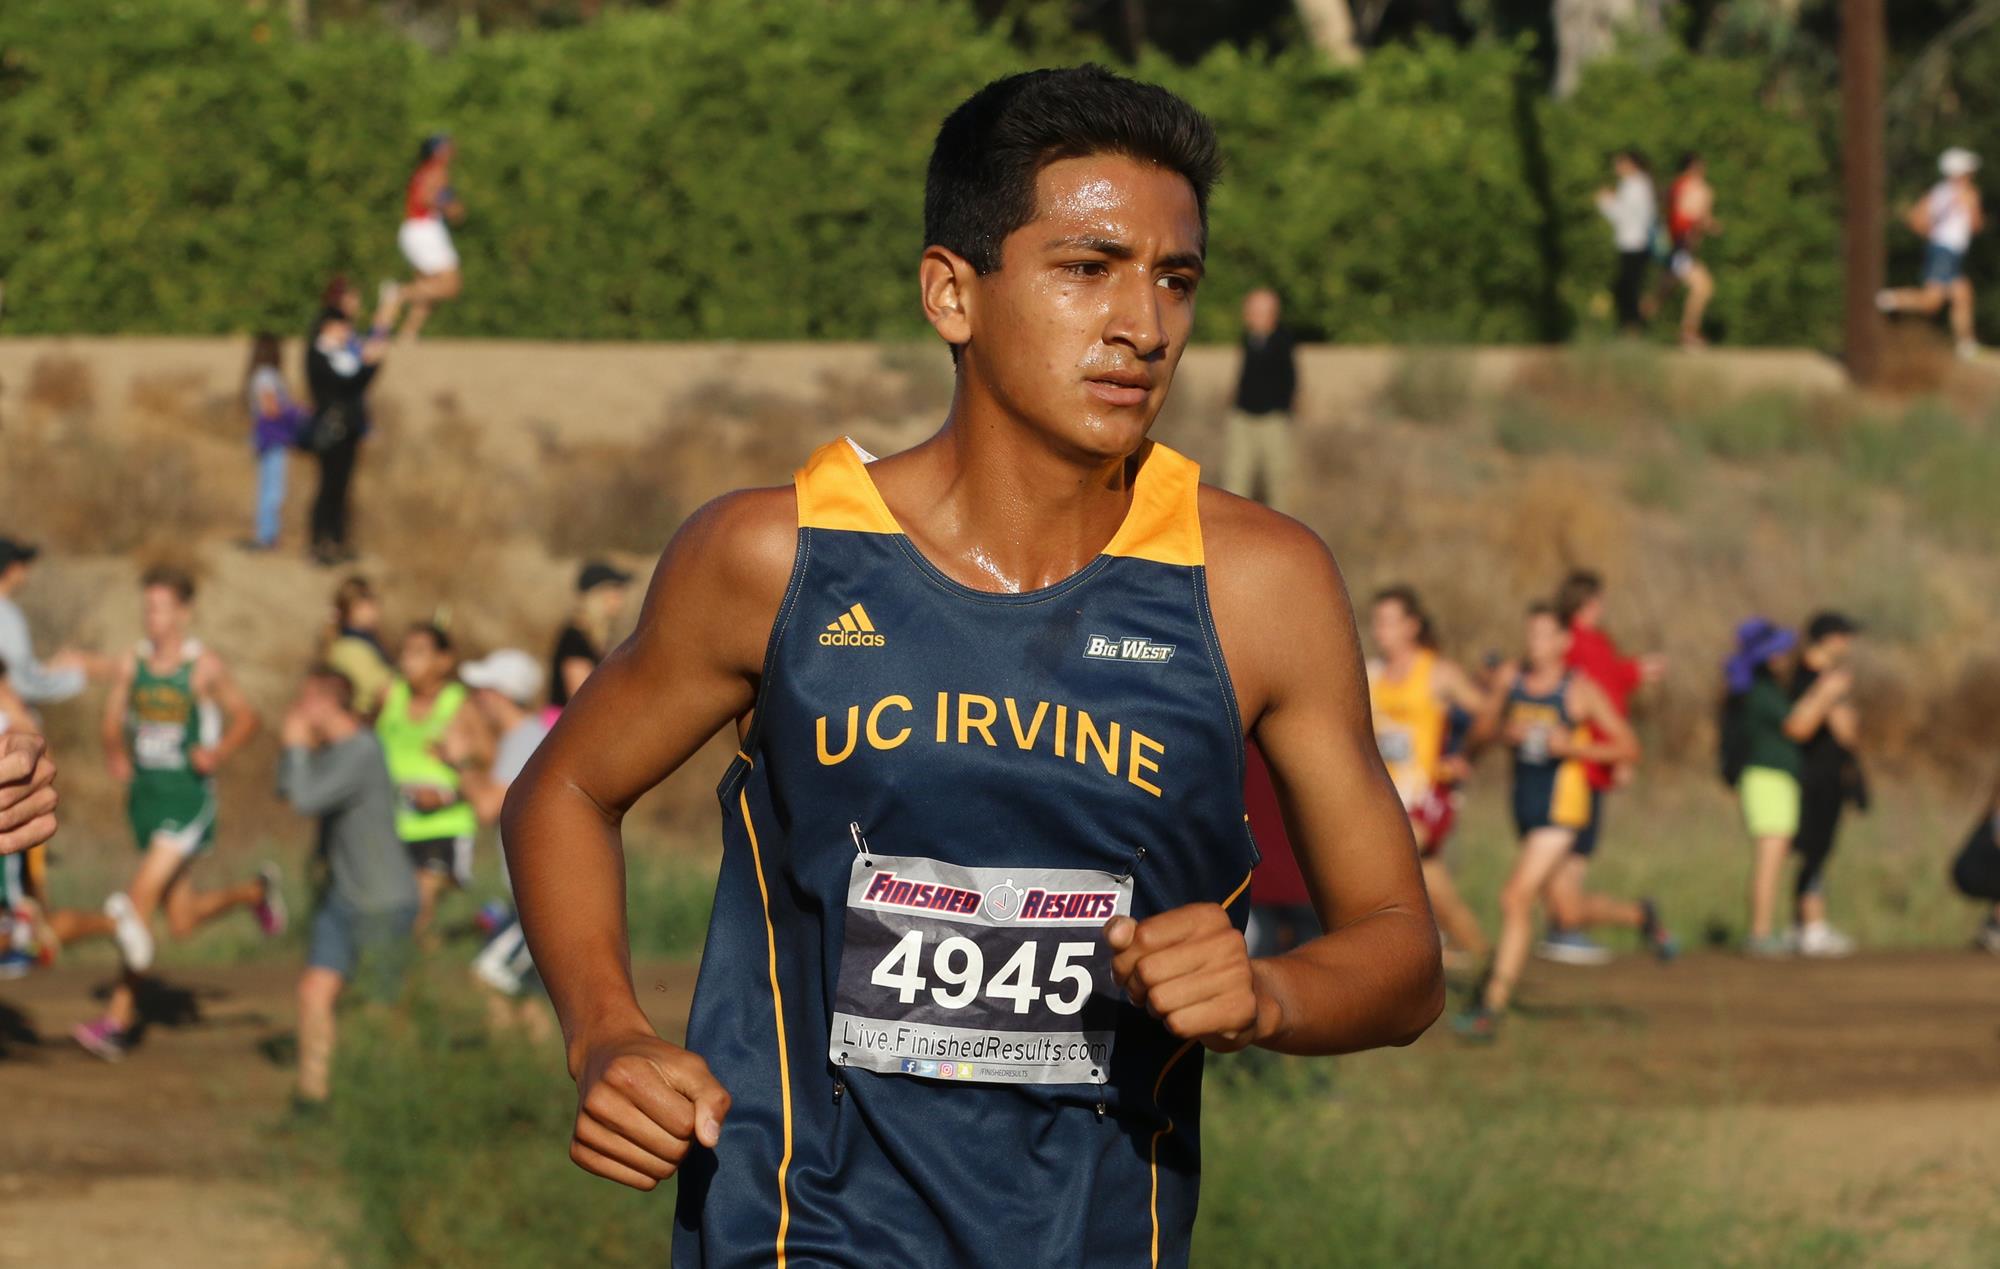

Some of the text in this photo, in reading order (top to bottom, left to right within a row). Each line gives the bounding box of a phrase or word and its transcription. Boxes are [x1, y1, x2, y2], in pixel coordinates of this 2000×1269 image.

[818, 630, 885, 647] adidas
[1087, 637, 1173, 660] BIG WEST
[816, 691, 1165, 798] UC IRVINE
[1017, 888, 1119, 920] RESULTS
[870, 929, 1096, 1016] 4945
[842, 1020, 1108, 1062] Live.FinishedResults.com
